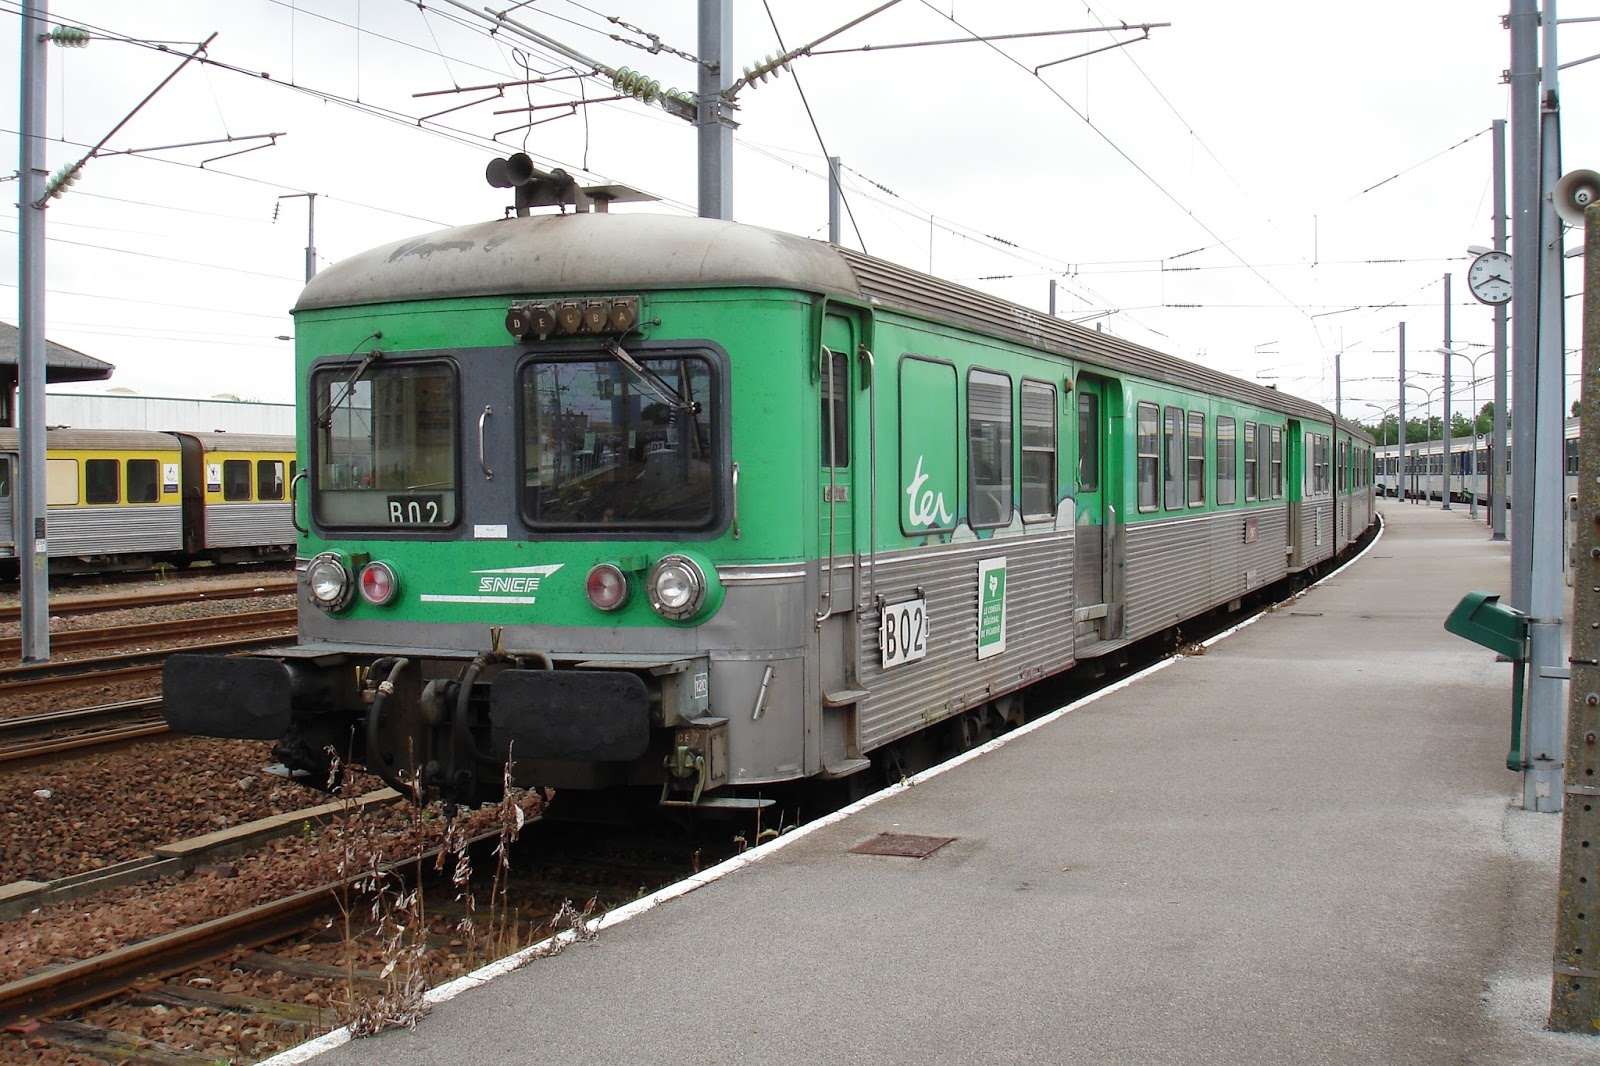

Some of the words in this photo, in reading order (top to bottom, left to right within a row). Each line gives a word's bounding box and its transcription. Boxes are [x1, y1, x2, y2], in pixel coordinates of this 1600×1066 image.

[514, 319, 520, 328] D
[539, 318, 545, 327] E
[567, 314, 573, 323] C
[593, 314, 599, 322] B
[619, 312, 625, 321] A
[906, 454, 953, 526] ter
[479, 577, 540, 592] SNCF
[988, 602, 1001, 613] CONSEIL
[886, 607, 923, 660] B02
